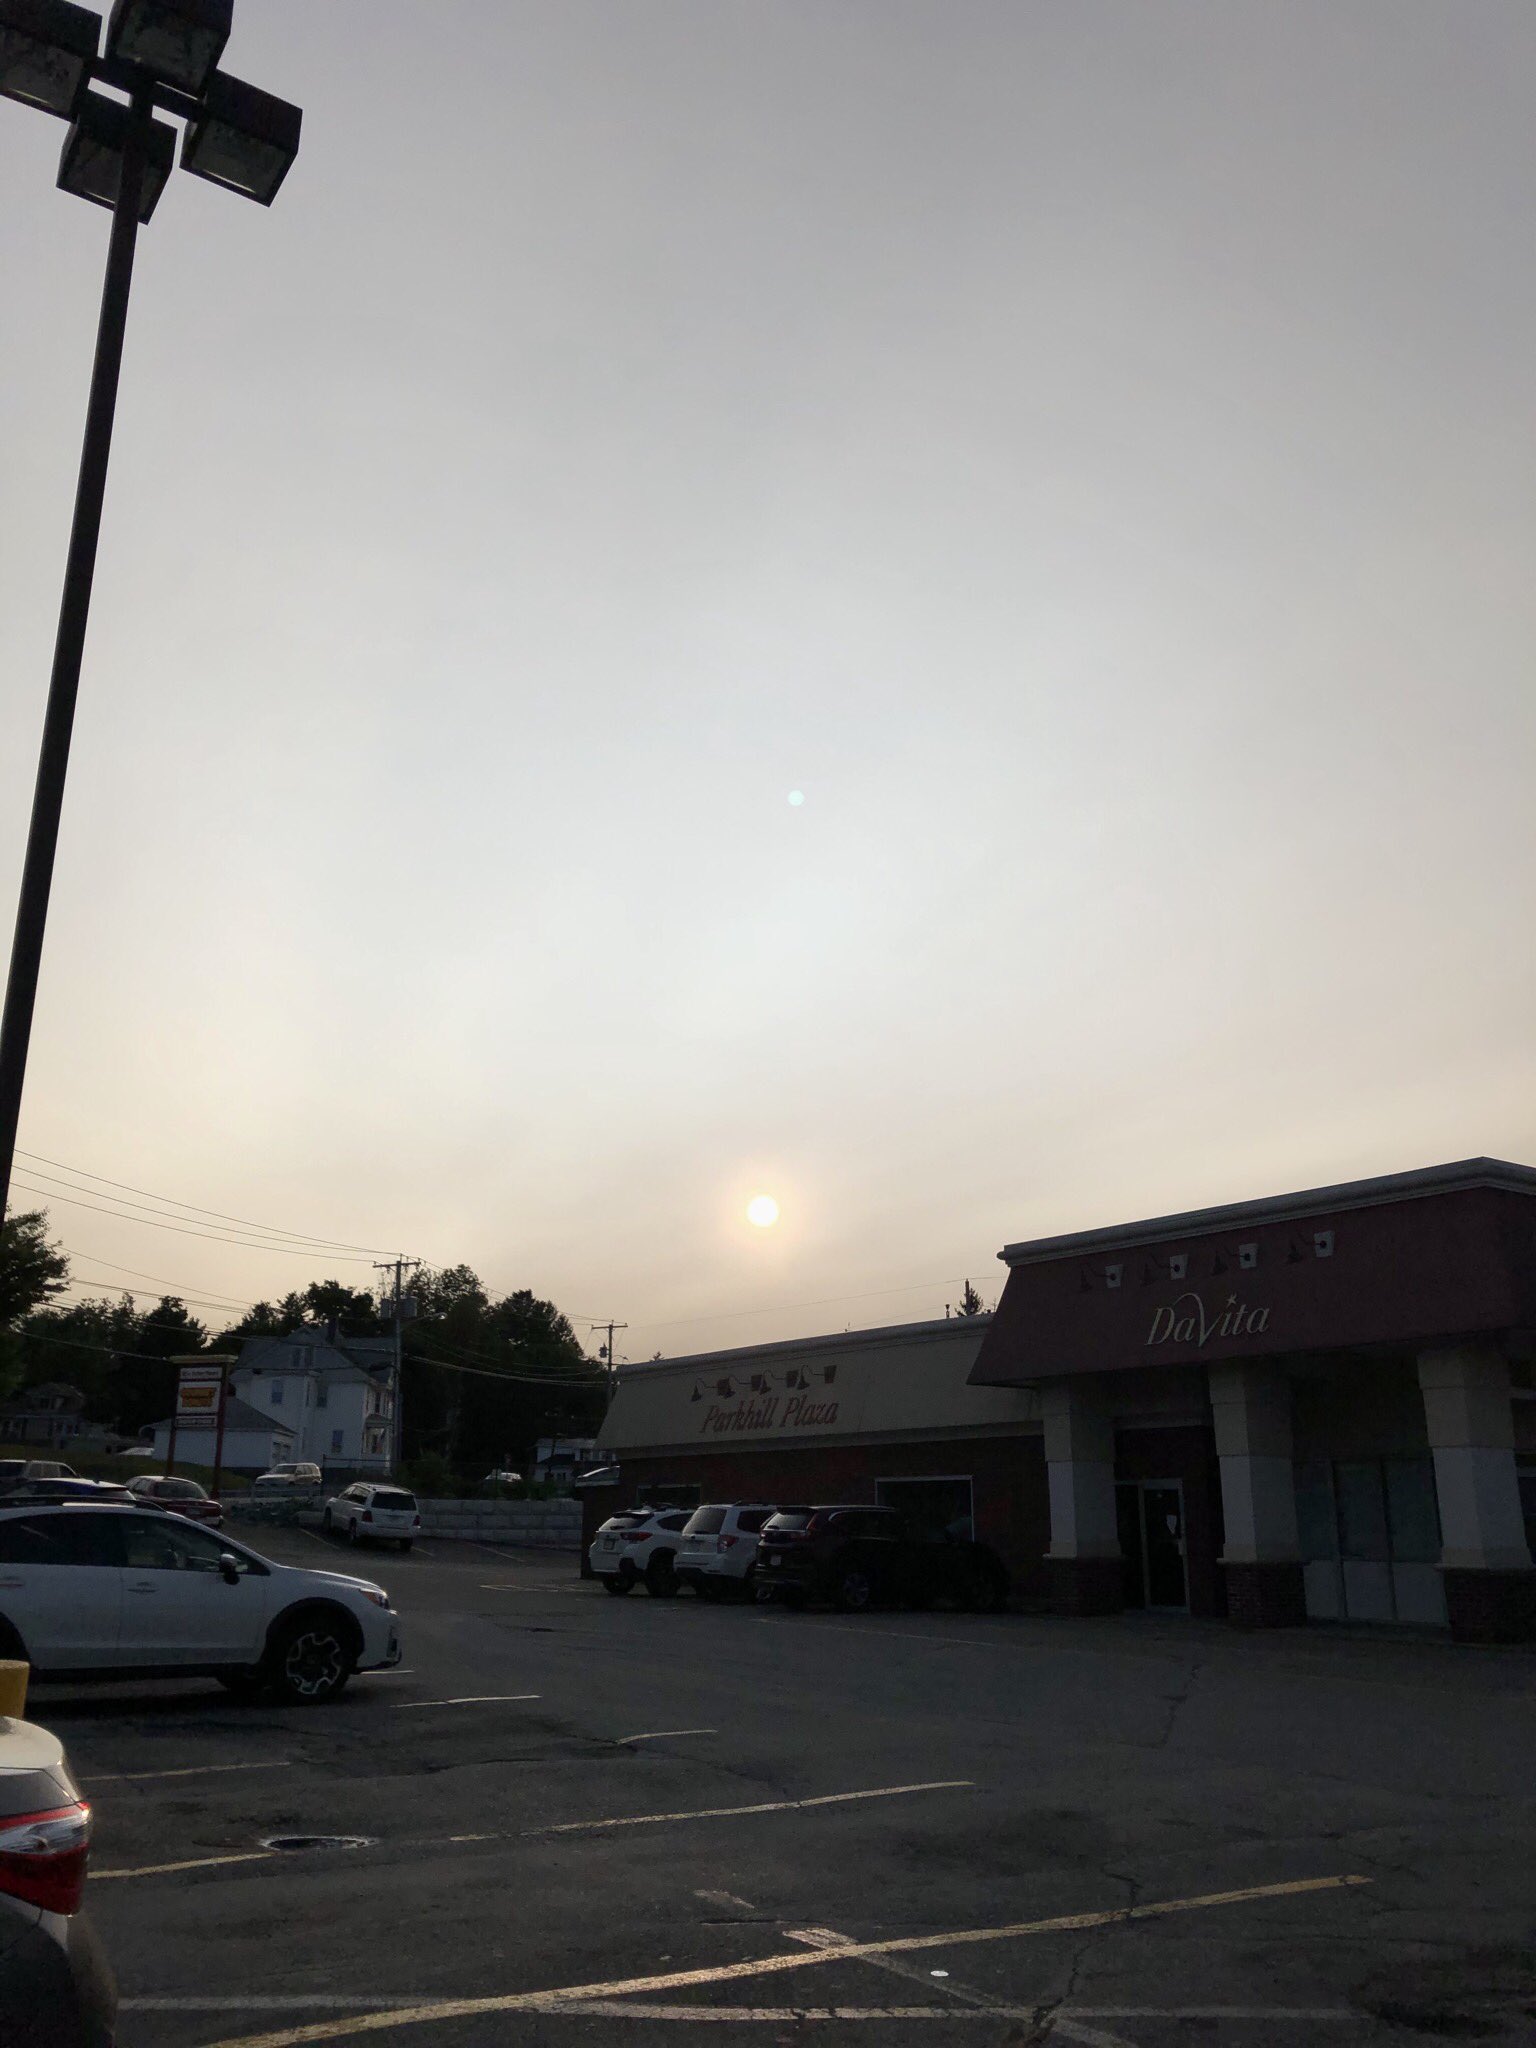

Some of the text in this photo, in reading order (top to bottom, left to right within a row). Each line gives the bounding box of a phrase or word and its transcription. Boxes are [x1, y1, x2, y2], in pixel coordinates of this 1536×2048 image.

[1144, 1292, 1270, 1347] DaVita
[699, 1394, 839, 1433] Parkhill Plaza
